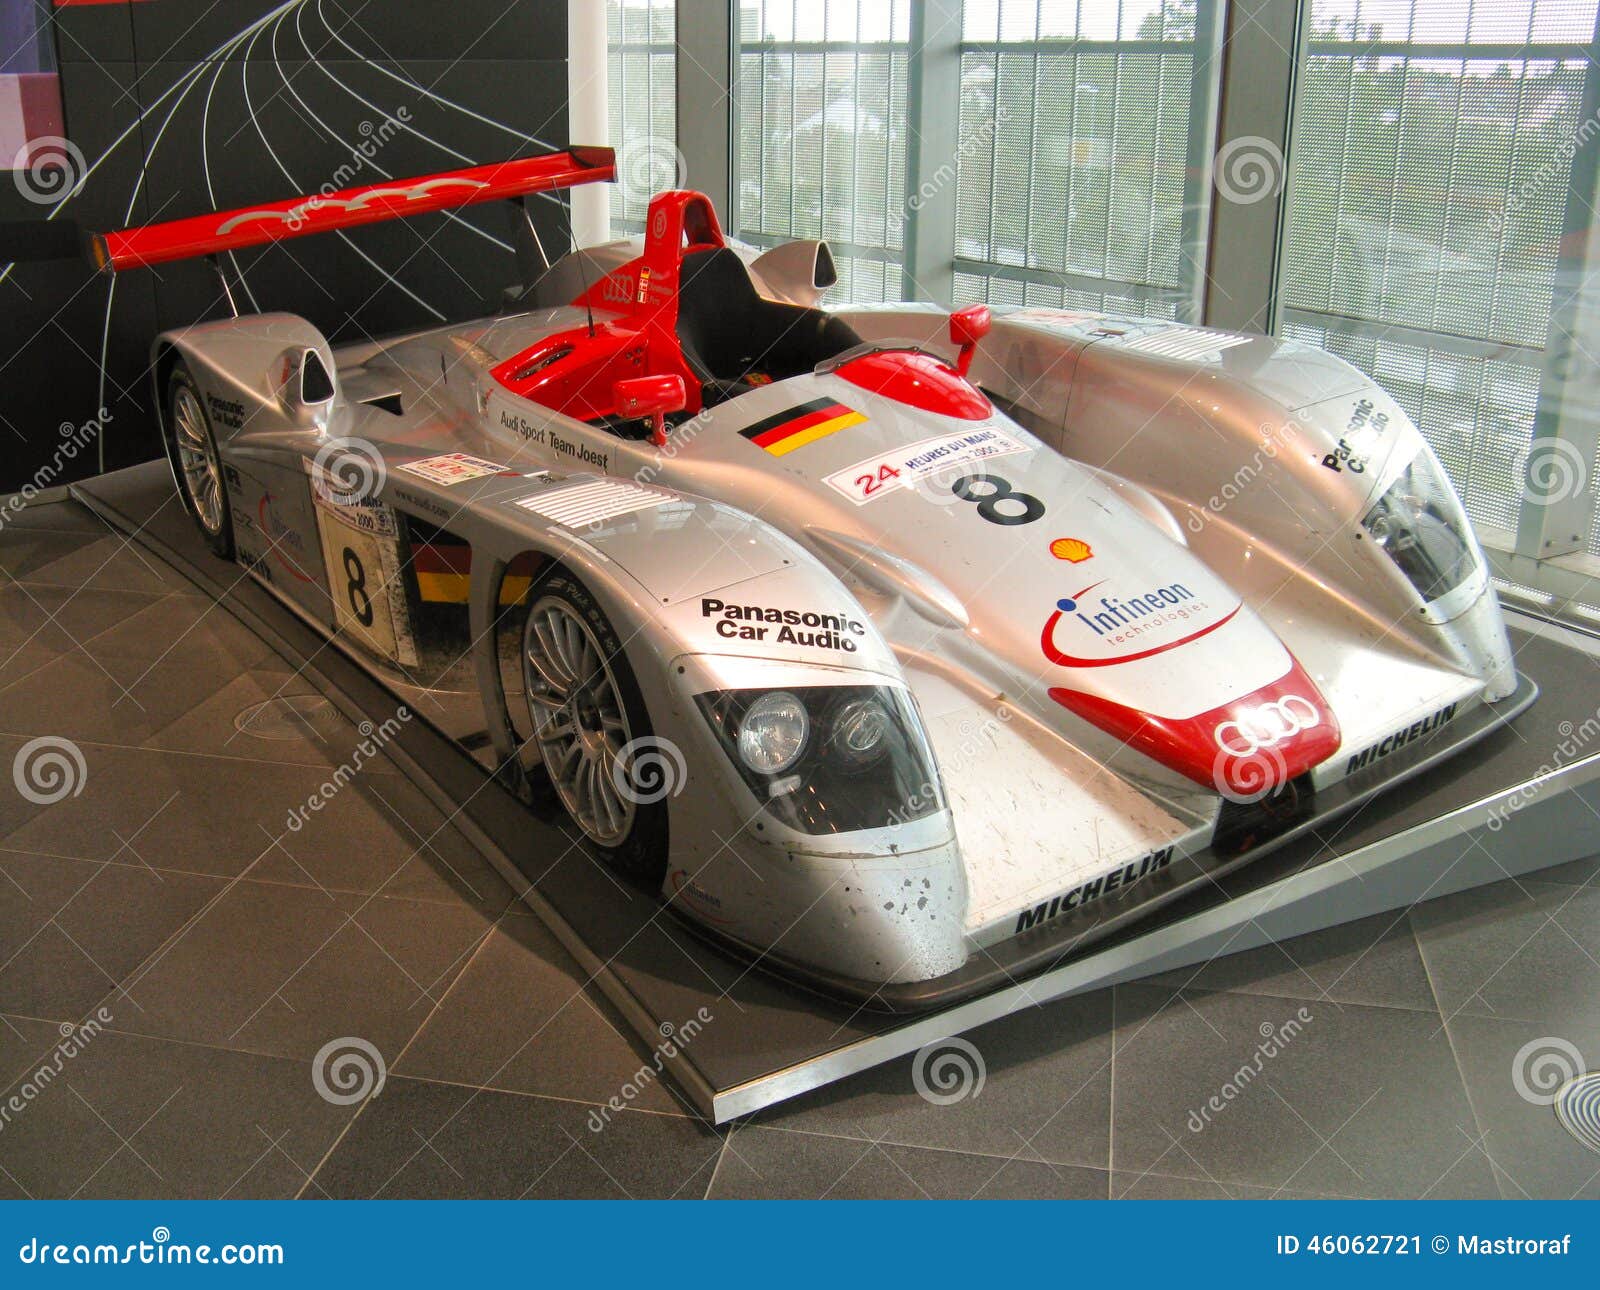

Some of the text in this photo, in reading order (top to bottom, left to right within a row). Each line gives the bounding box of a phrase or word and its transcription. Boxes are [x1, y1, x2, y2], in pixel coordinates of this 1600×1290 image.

[501, 410, 608, 470] Audi Sport Team Joest
[855, 462, 901, 495] 24
[904, 446, 951, 470] HEURES
[950, 440, 966, 453] DU
[965, 431, 998, 445] MANS
[952, 473, 1046, 526] 8
[342, 546, 374, 628] 8
[1076, 583, 1195, 635] Infineon
[701, 598, 865, 635] Panasonic
[716, 619, 858, 653] Car Audio
[1106, 600, 1209, 647] technologies
[1344, 701, 1458, 775] MICHELIN
[1015, 844, 1175, 934] MICHELIN
